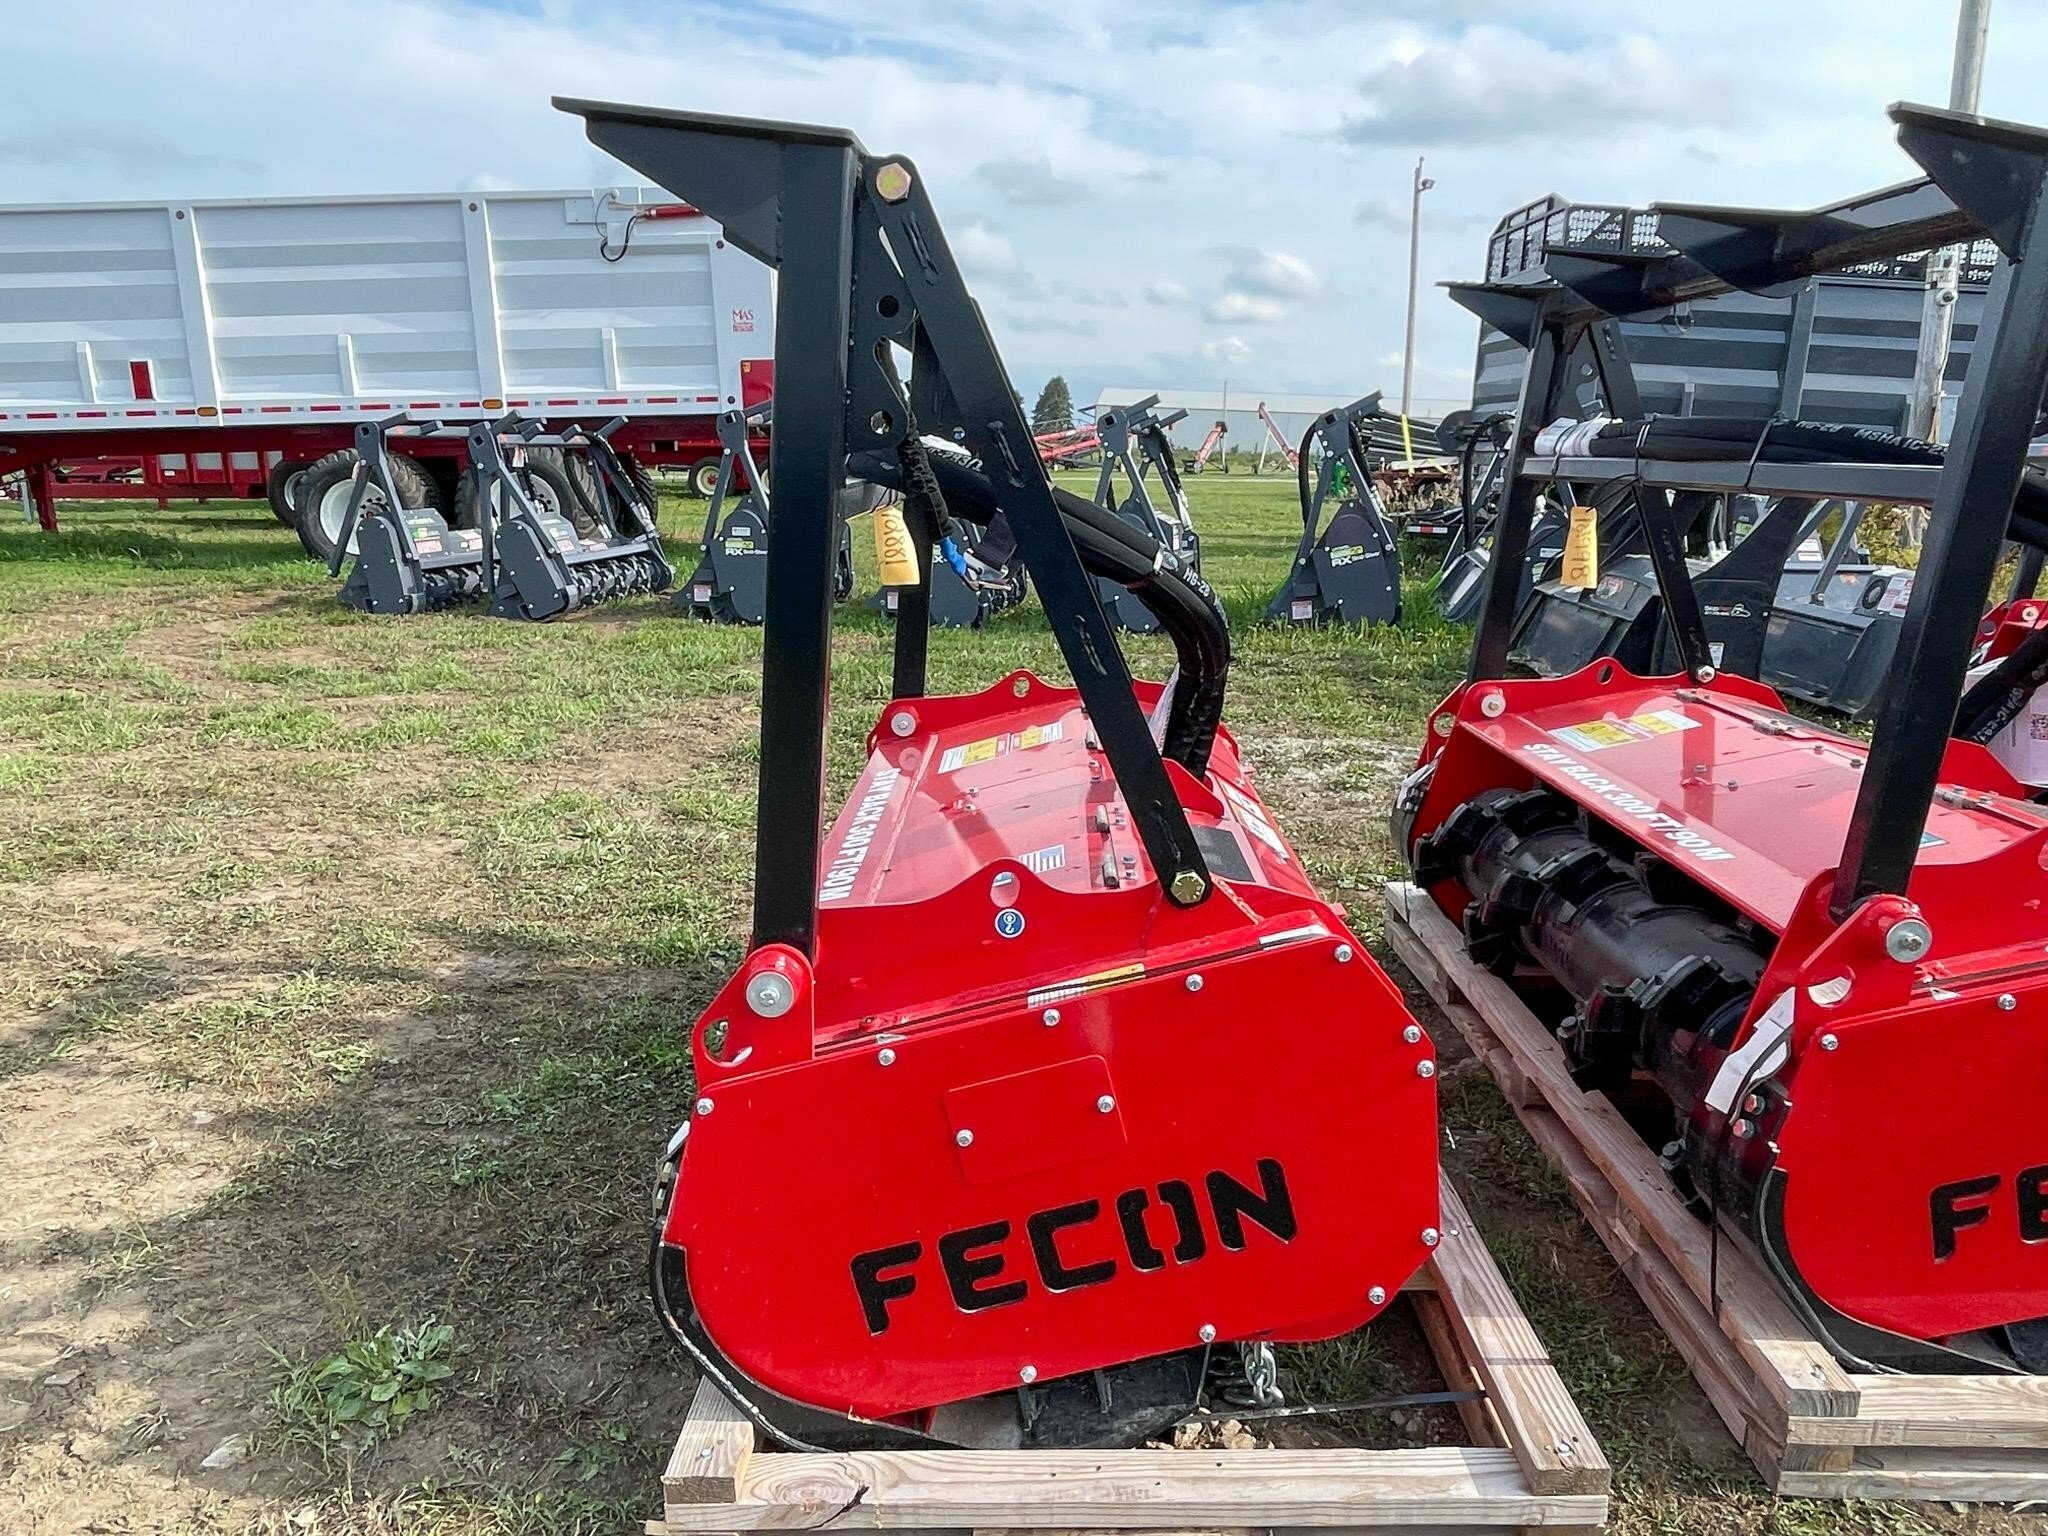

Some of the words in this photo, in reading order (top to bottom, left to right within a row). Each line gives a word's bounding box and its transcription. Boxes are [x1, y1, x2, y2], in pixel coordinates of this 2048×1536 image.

[732, 309, 754, 321] MAS
[1854, 427, 1900, 446] MSHA
[869, 767, 901, 795] STAY
[853, 791, 889, 826] BACK
[1523, 742, 1575, 768] STAY
[1559, 763, 1621, 794] BACK
[1604, 789, 1655, 816] 300
[1642, 811, 1736, 862] FT/90M
[842, 822, 877, 849] 300
[849, 1156, 1298, 1337] FECON
